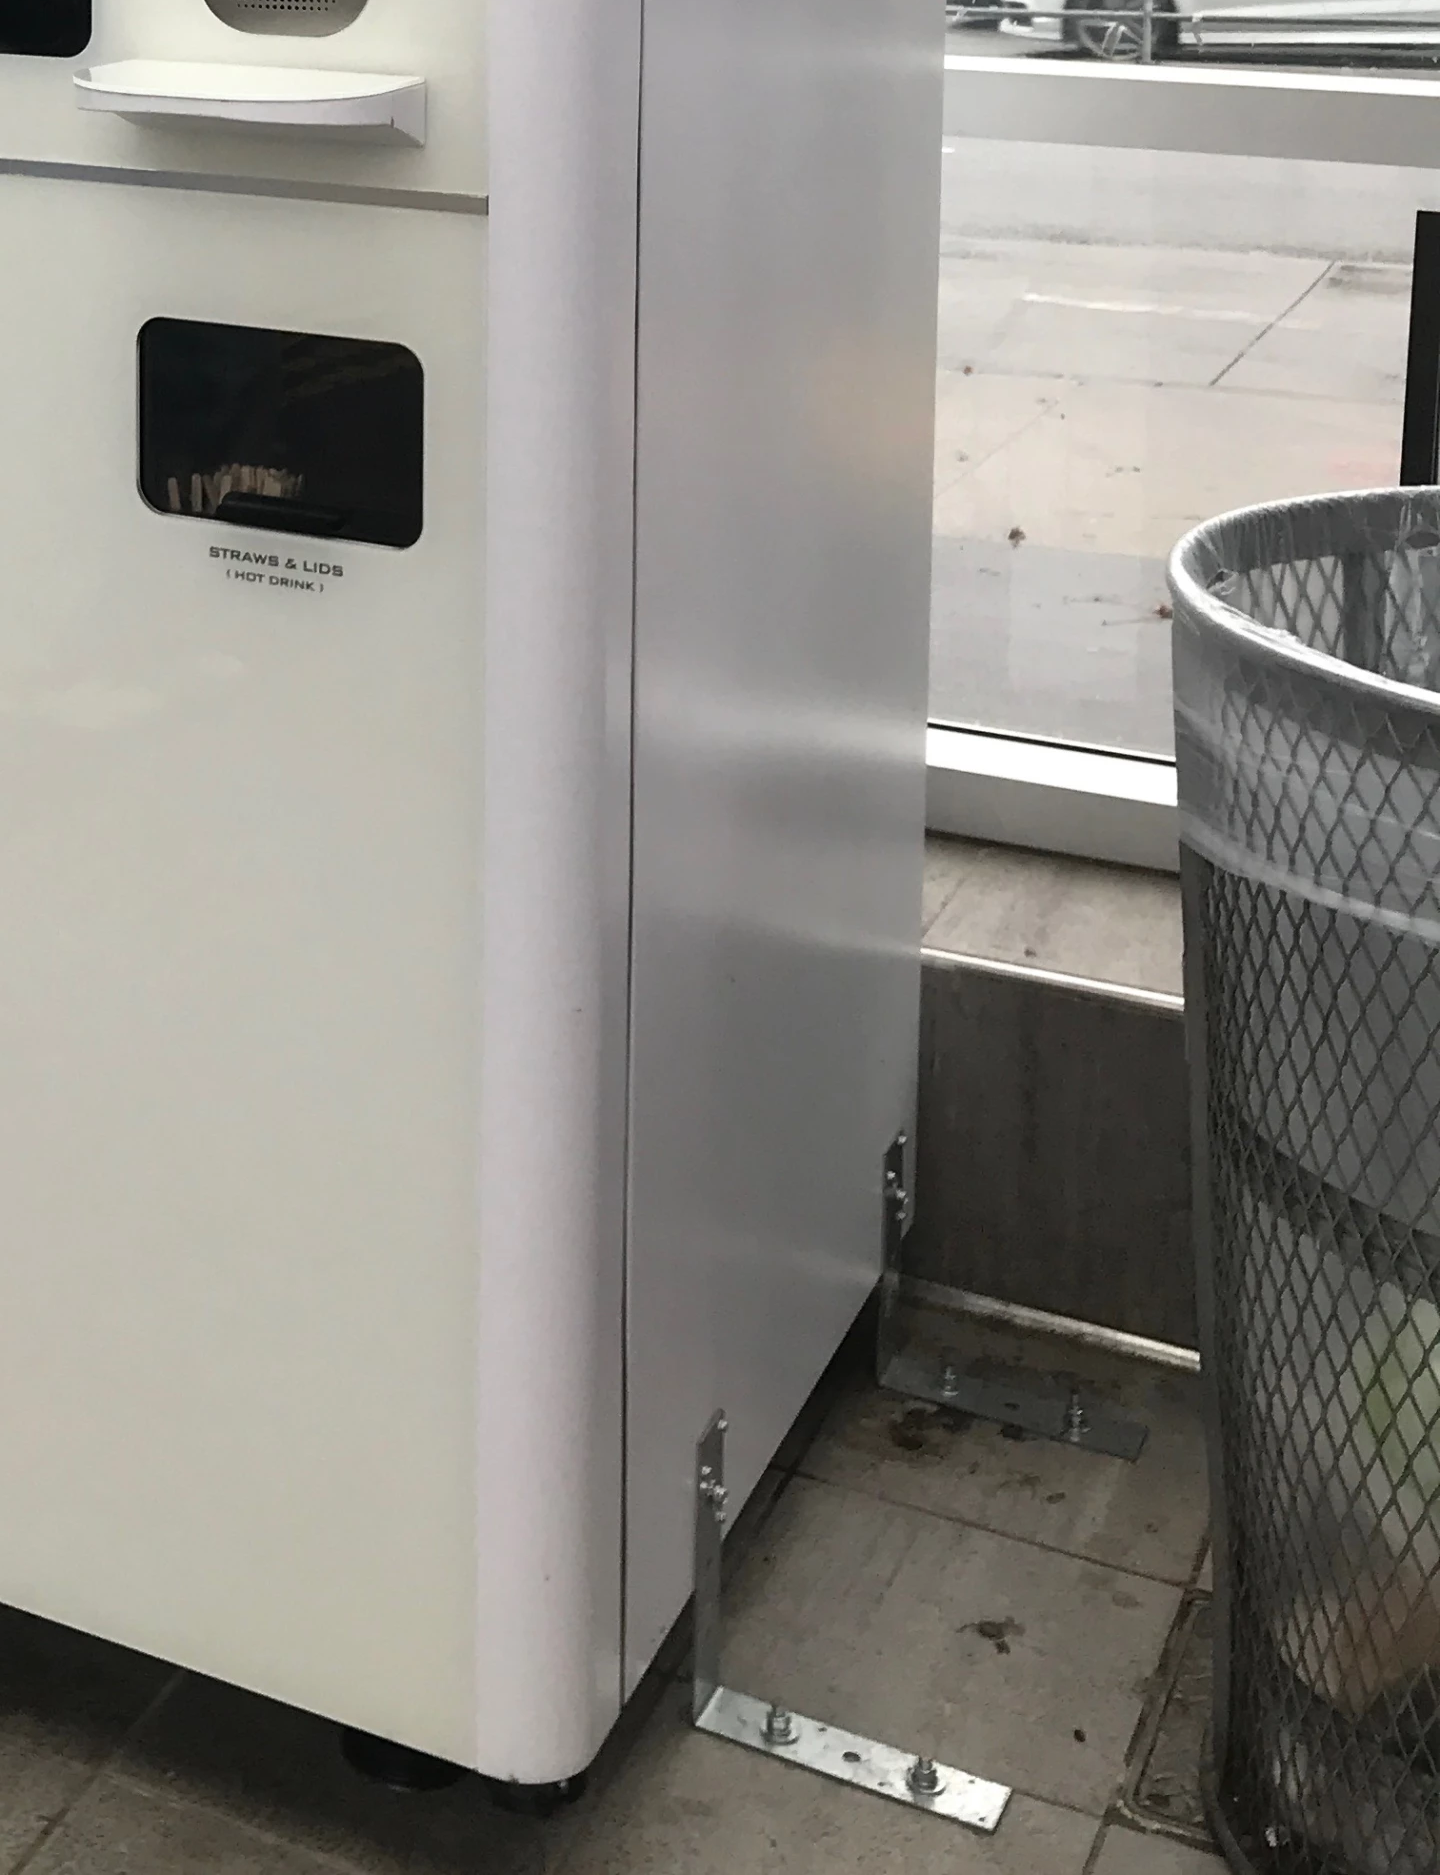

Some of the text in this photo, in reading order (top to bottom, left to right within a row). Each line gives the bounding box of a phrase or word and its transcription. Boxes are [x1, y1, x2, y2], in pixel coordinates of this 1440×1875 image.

[209, 546, 344, 577] STRAWS & LIDS
[235, 571, 265, 583] HOT
[269, 576, 315, 592] DRINK
